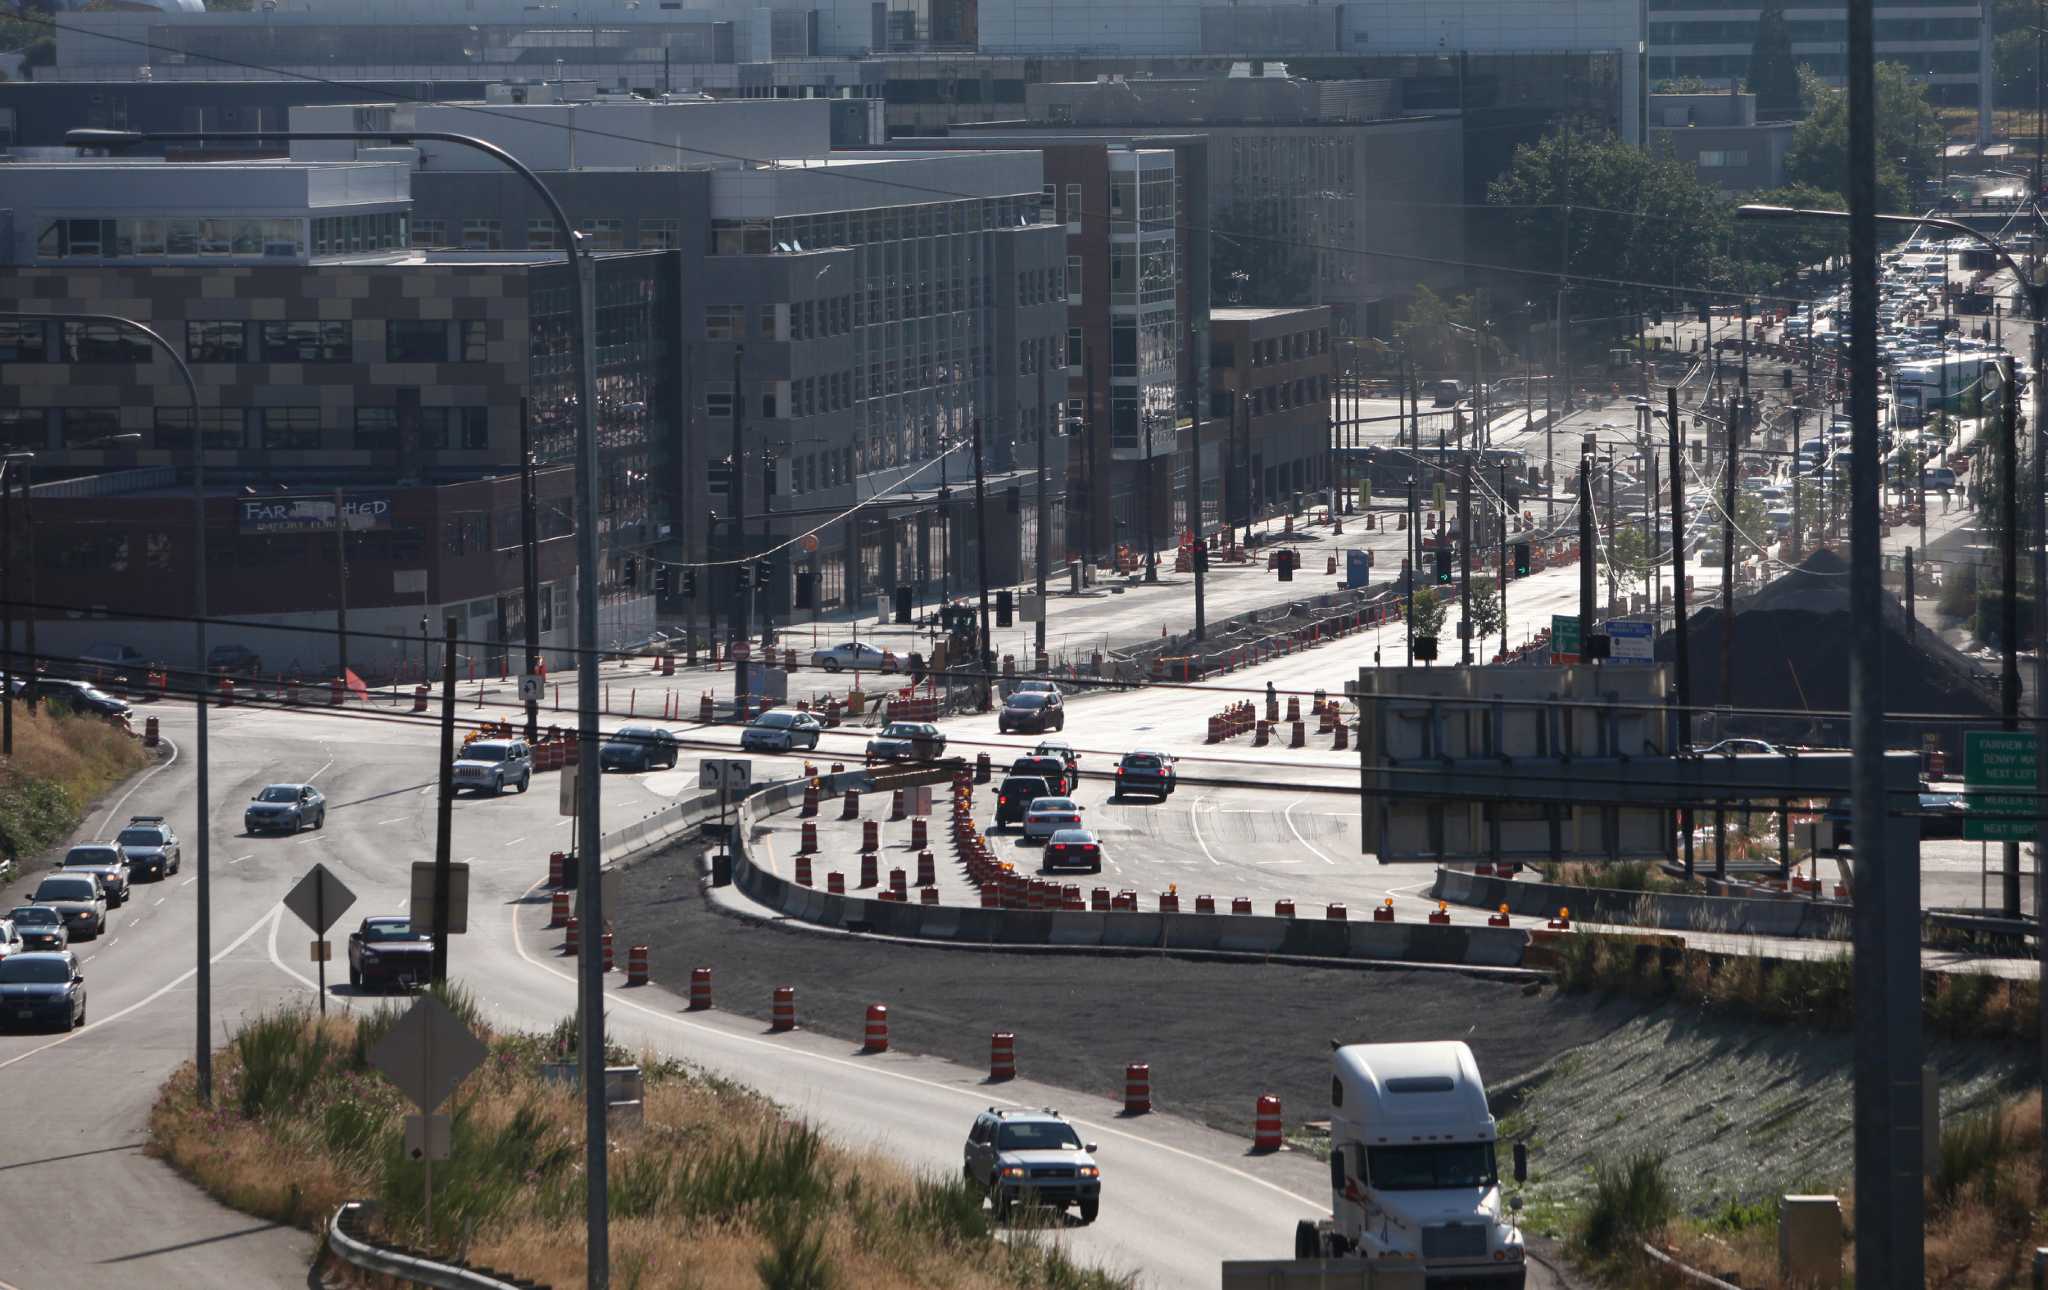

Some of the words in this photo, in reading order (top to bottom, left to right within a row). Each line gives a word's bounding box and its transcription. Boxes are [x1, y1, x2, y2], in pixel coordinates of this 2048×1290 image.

[244, 502, 287, 520] FAR
[1983, 754, 2015, 764] DENNY
[1985, 768, 2009, 778] NEXT
[1983, 823, 2007, 833] NEXT
